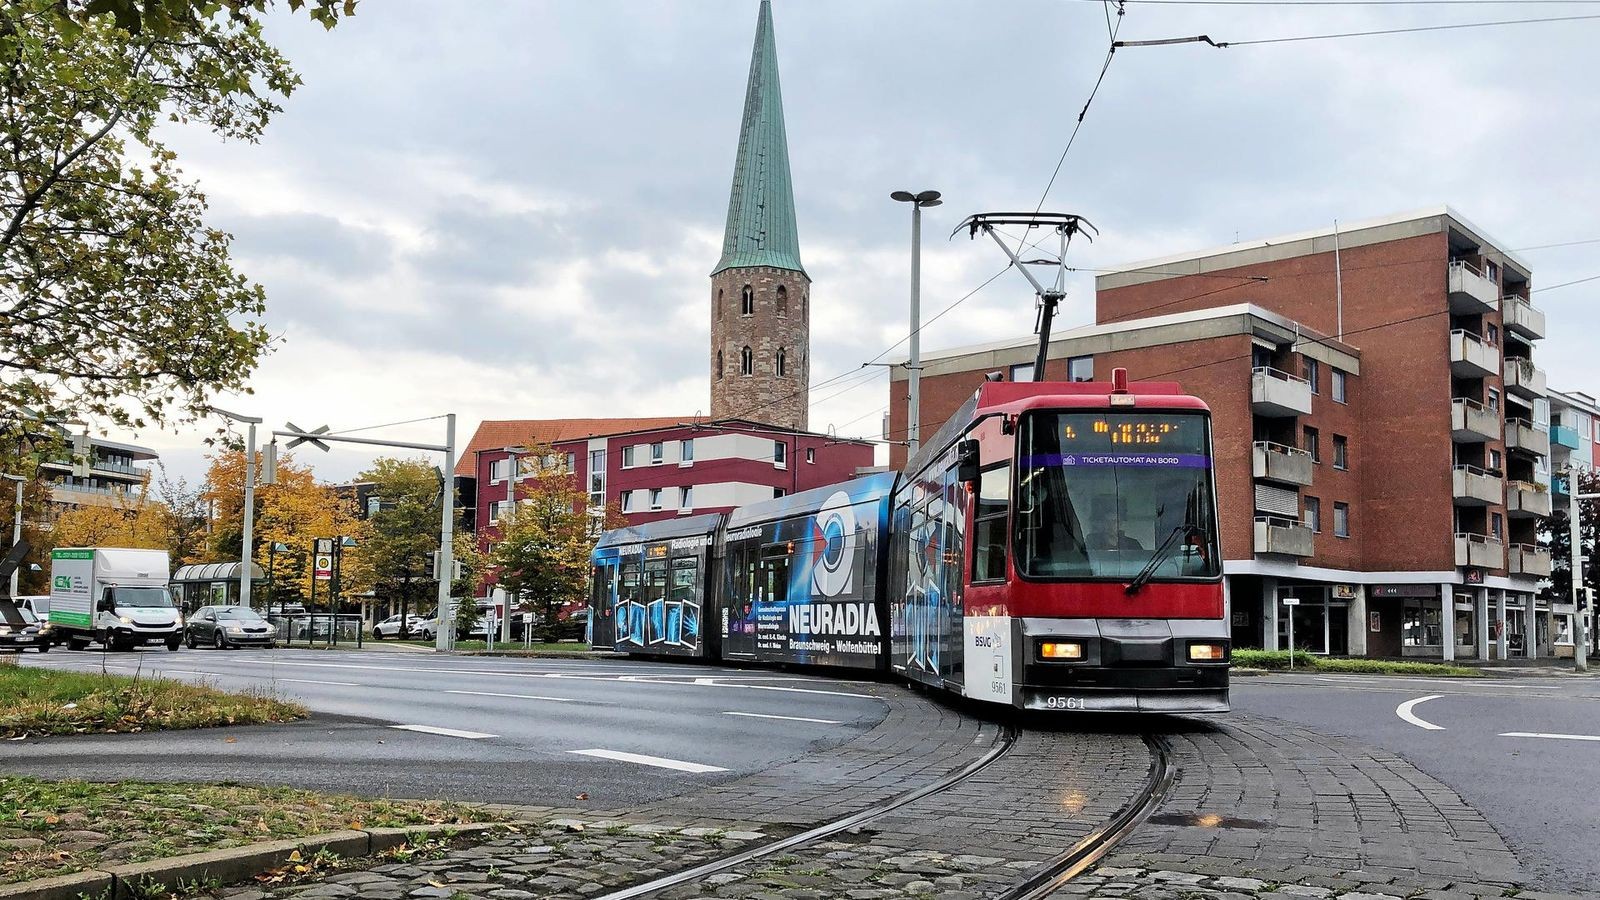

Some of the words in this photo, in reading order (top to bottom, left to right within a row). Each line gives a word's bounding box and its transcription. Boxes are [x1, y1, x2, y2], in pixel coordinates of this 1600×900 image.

[1082, 456, 1144, 464] TICKETAUTOMAT
[671, 536, 699, 550] Radiologie
[700, 535, 713, 546] und
[789, 603, 881, 636] NEURADIA
[789, 638, 830, 654] Braunschweig
[836, 640, 881, 654] Wolfenbüttel
[975, 636, 992, 648] BSVG
[991, 681, 1006, 694] 9561
[1047, 696, 1085, 709] 9561
